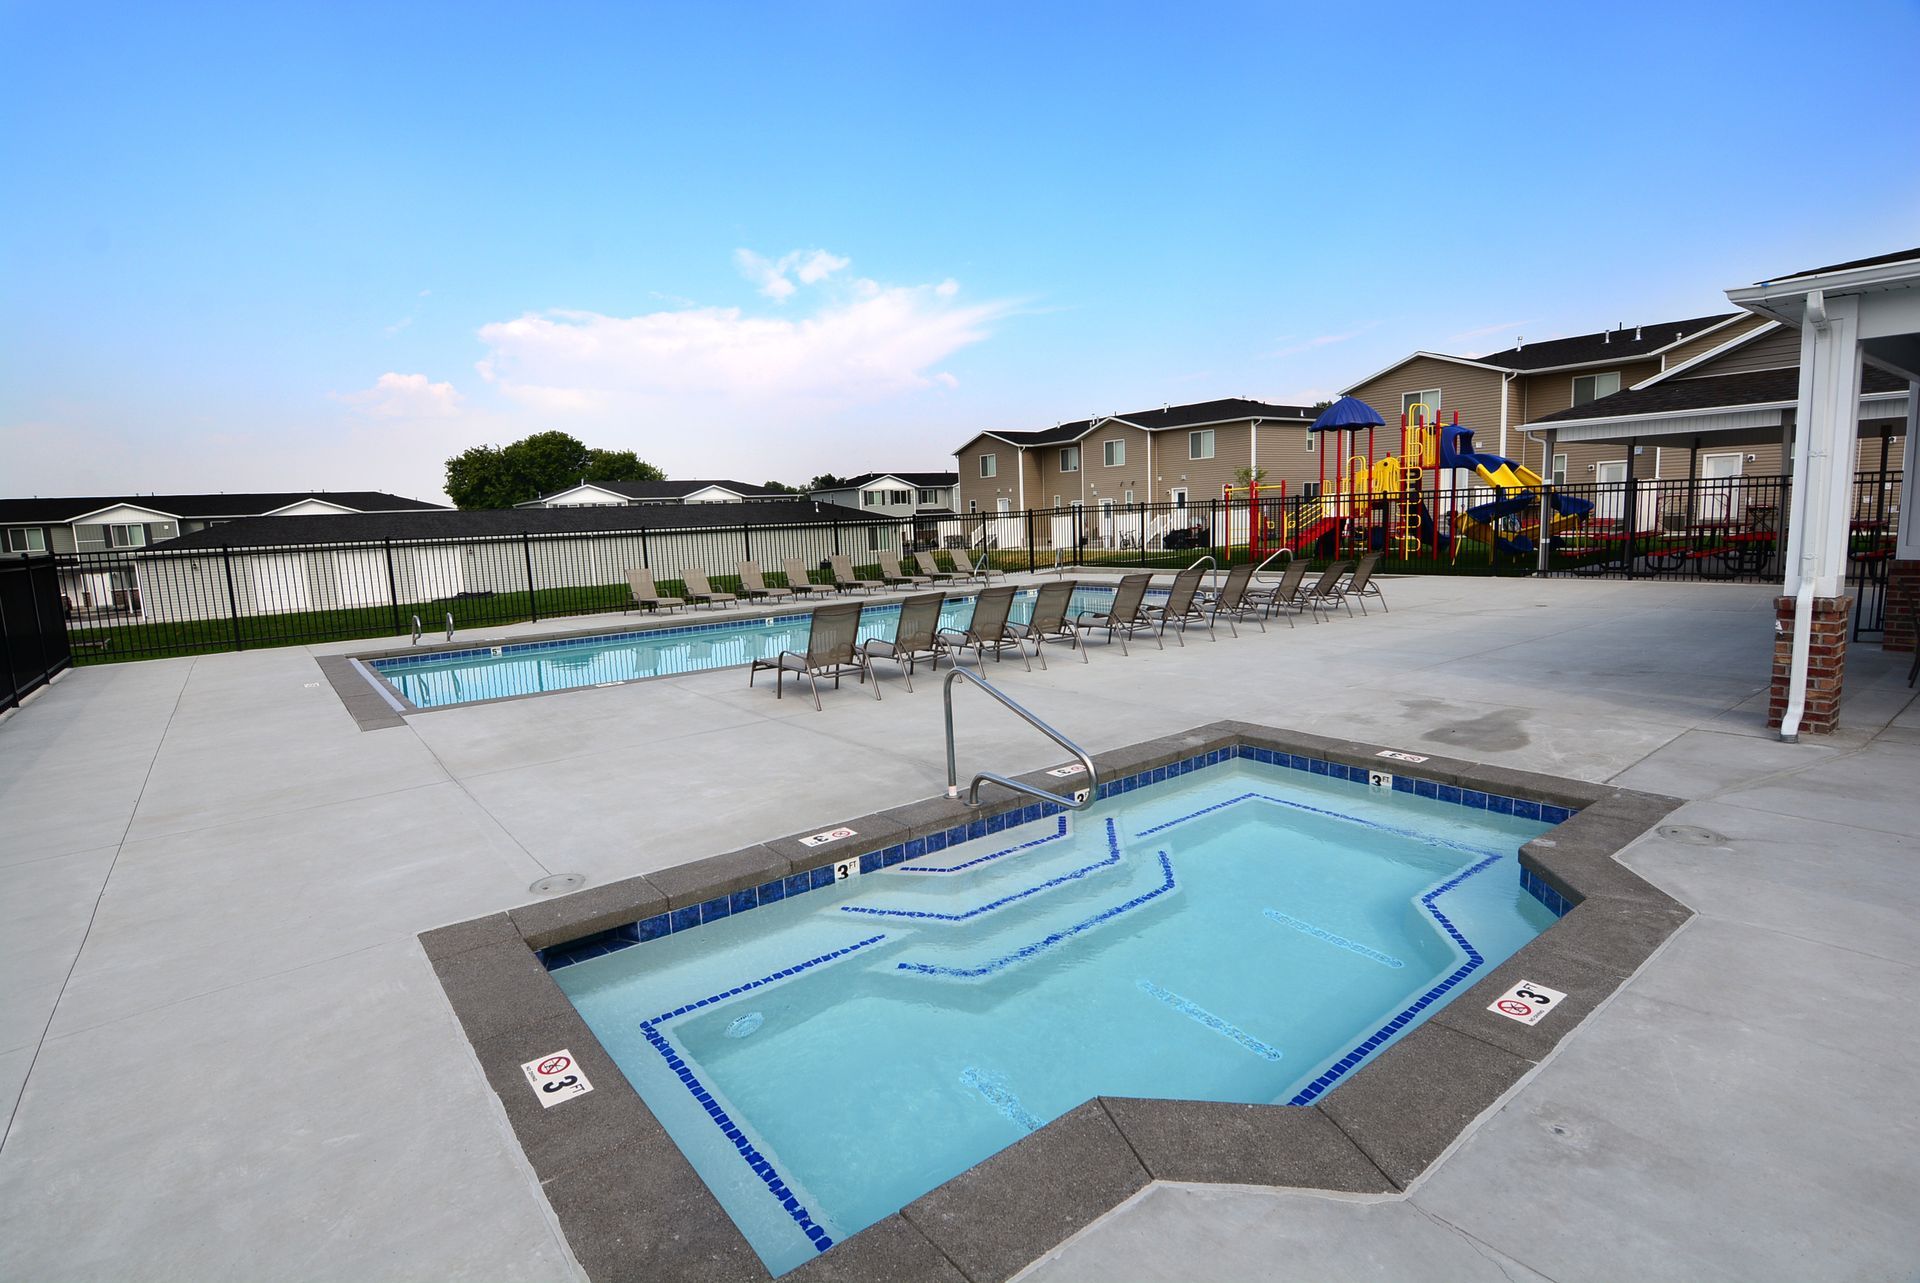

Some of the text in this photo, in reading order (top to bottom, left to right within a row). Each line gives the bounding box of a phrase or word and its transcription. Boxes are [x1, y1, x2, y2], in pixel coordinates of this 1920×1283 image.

[1372, 774, 1382, 787] 3
[837, 861, 857, 880] 3 FT
[1516, 983, 1551, 1005] 3 FT
[543, 1075, 586, 1093] 3 FT
